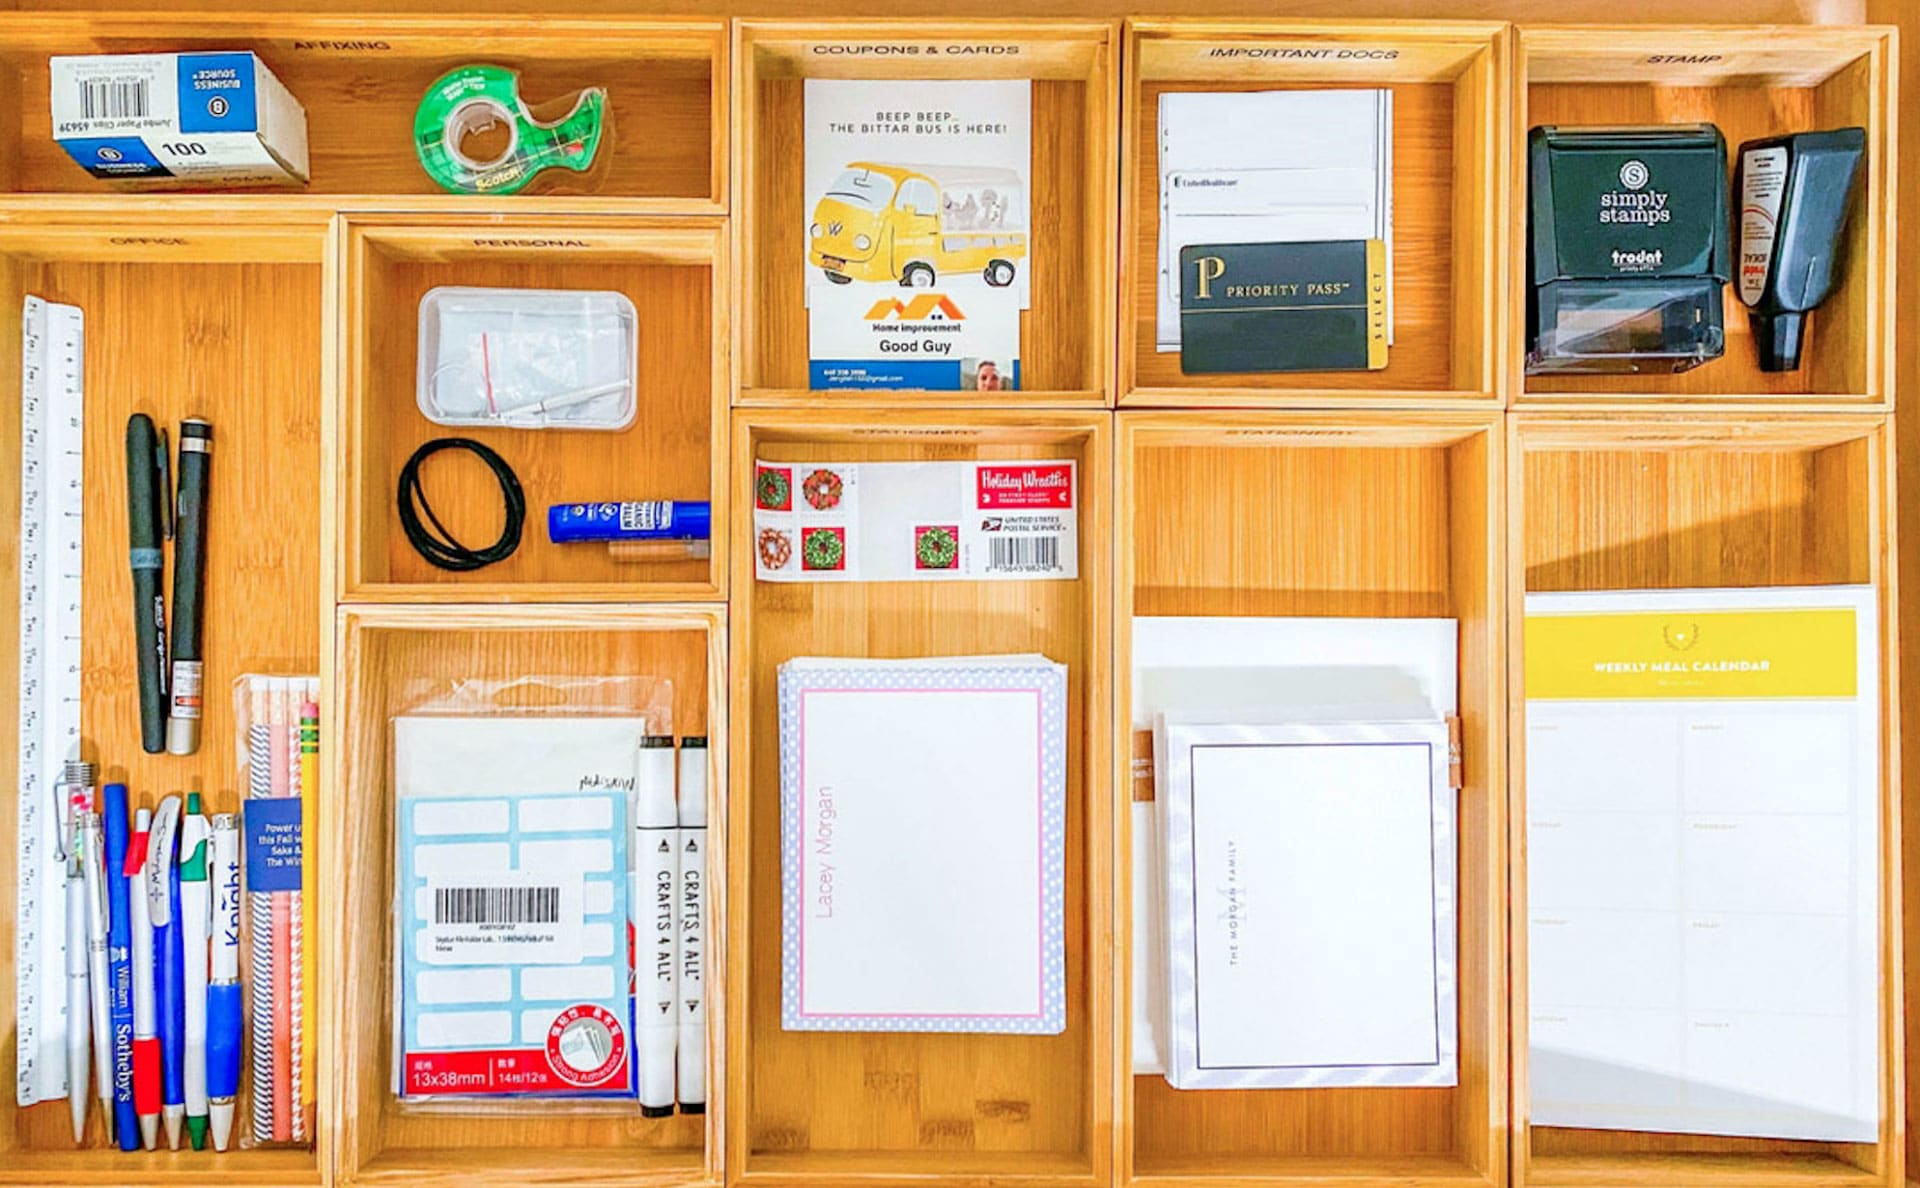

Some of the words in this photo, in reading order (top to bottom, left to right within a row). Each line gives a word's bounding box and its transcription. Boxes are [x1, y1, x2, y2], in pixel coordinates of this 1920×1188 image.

[294, 40, 391, 51] AFFIXING
[813, 45, 920, 55] COUPONS
[926, 45, 939, 55] &
[946, 45, 1020, 55] CARDS
[1209, 47, 1331, 59] IMPORTANT
[1336, 49, 1400, 61] DOCS
[1647, 55, 1723, 64] STAMP
[193, 79, 241, 89] BUSINESS
[142, 118, 173, 129] Jumbo
[876, 111, 912, 122] BEEP
[94, 120, 116, 131] Clips
[116, 119, 141, 130] Paper
[829, 123, 855, 134] THE
[861, 123, 910, 134] BITTAR
[915, 123, 942, 134] BUS
[948, 123, 960, 134] IS
[967, 123, 1007, 134] HERE!
[162, 141, 207, 157] 100
[474, 166, 521, 191] Scotch
[1600, 189, 1669, 210] simply
[1599, 205, 1671, 226] stamps
[110, 236, 189, 246] OFFICE
[473, 238, 591, 248] PERSONAL
[1611, 249, 1663, 265] trodat
[1192, 255, 1226, 299] P
[1226, 284, 1300, 298] PRIORITY
[1373, 272, 1383, 340] SELECT
[872, 322, 900, 333] Home
[879, 339, 919, 353] Good
[922, 339, 952, 356] Guy
[982, 469, 1022, 491] Holiday
[1022, 469, 1069, 488] Wreaths
[1594, 661, 1647, 674] WEEKLY
[1651, 661, 1689, 673] MEAL
[1692, 660, 1770, 673] CALENDAR
[265, 823, 293, 833] Power
[815, 786, 838, 856] Morgan
[276, 834, 293, 844] Fall
[267, 857, 284, 867] The
[1227, 840, 1237, 883] FAMILY
[815, 863, 838, 919] Lacey
[657, 870, 671, 931] CRAFTS
[684, 870, 699, 931] CRAFTS
[1228, 886, 1239, 939] MORGAN
[657, 937, 671, 946] 4
[684, 937, 700, 946] 4
[1229, 944, 1239, 966] THE
[115, 1023, 134, 1102] Sotheby's
[553, 1055, 579, 1082] Strong
[413, 1071, 486, 1088] 13x38mm
